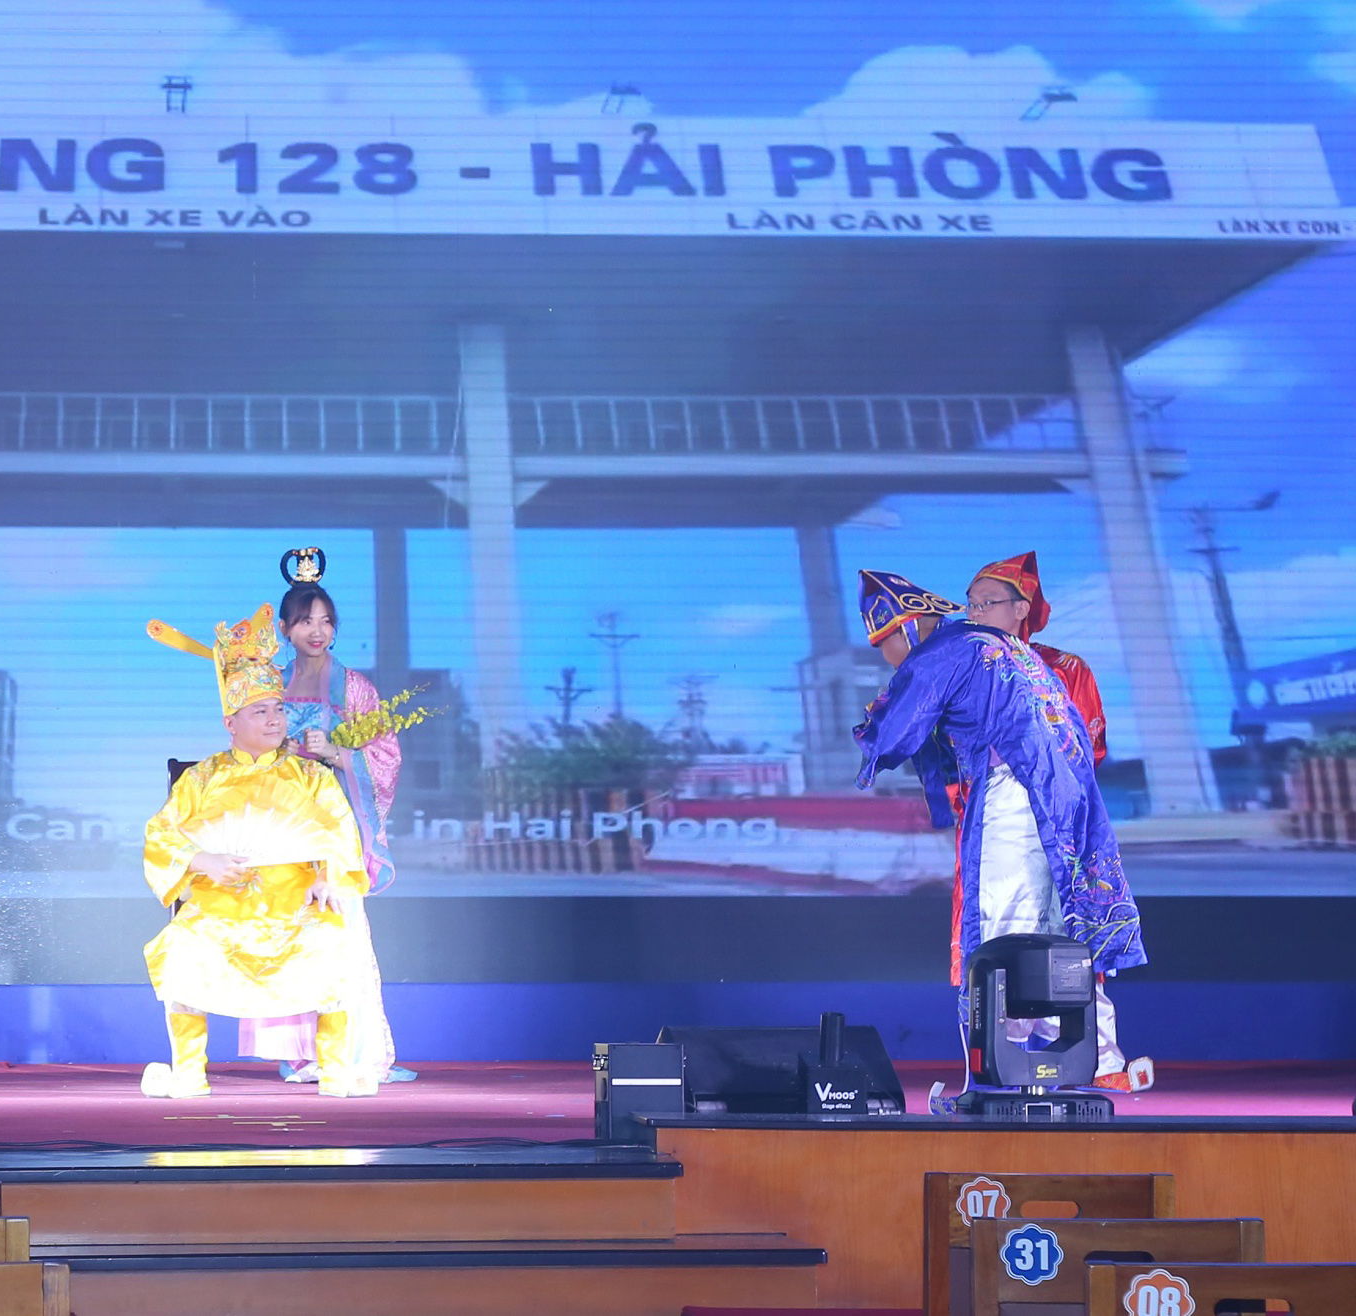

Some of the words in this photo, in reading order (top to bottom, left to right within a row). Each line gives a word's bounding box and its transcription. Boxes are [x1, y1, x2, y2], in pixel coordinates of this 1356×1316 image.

[217, 141, 418, 195] 128
[530, 122, 727, 197] HẢI
[767, 132, 1172, 201] PHÒNG
[38, 204, 129, 226] LÀN
[146, 209, 202, 227] XE
[217, 205, 312, 227] VÀO
[727, 209, 816, 231] LÀN
[937, 213, 993, 232] XE
[413, 809, 462, 841] in
[483, 809, 573, 841] Hai
[967, 1189, 1000, 1219] 07
[1015, 1238, 1050, 1271] 31
[1138, 1285, 1182, 1316] 08
